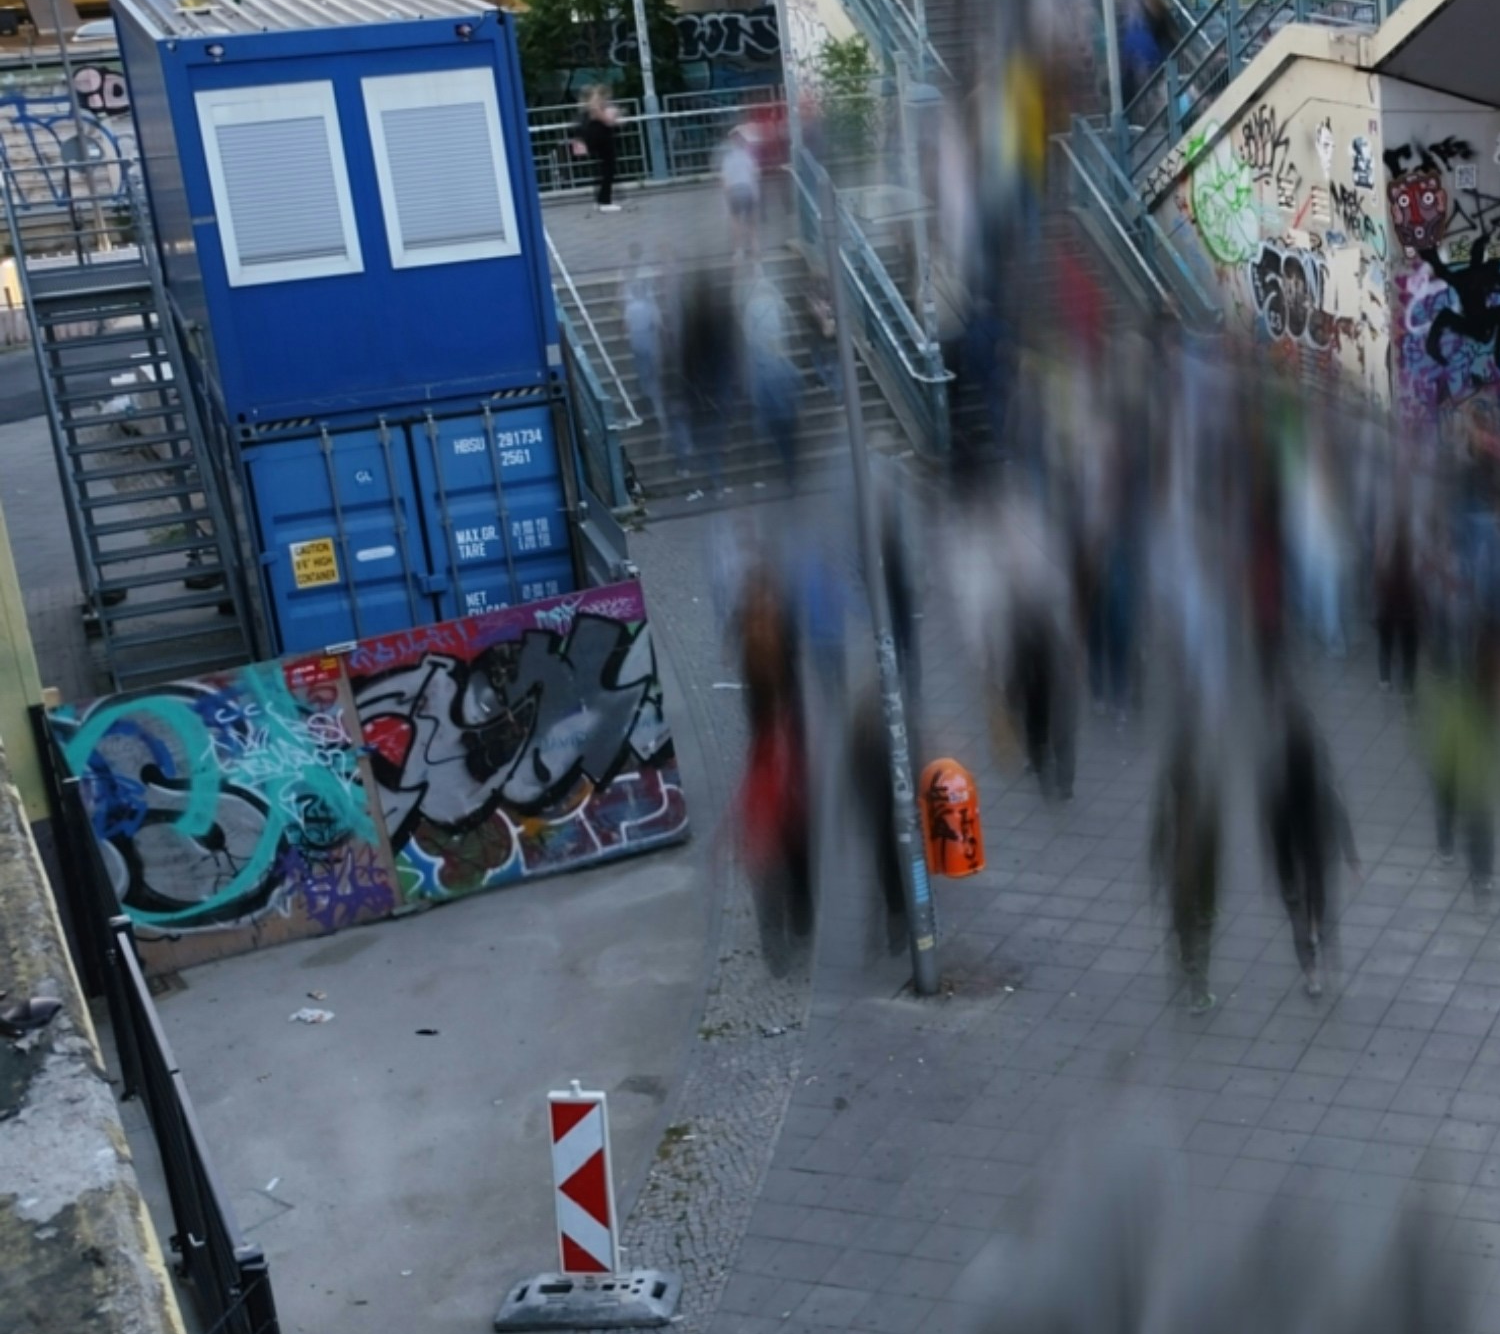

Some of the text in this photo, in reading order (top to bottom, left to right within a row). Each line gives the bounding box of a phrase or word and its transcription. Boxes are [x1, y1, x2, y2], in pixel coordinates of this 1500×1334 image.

[453, 436, 486, 455] HBSU
[458, 542, 487, 560] TARE
[465, 590, 488, 608] NET
